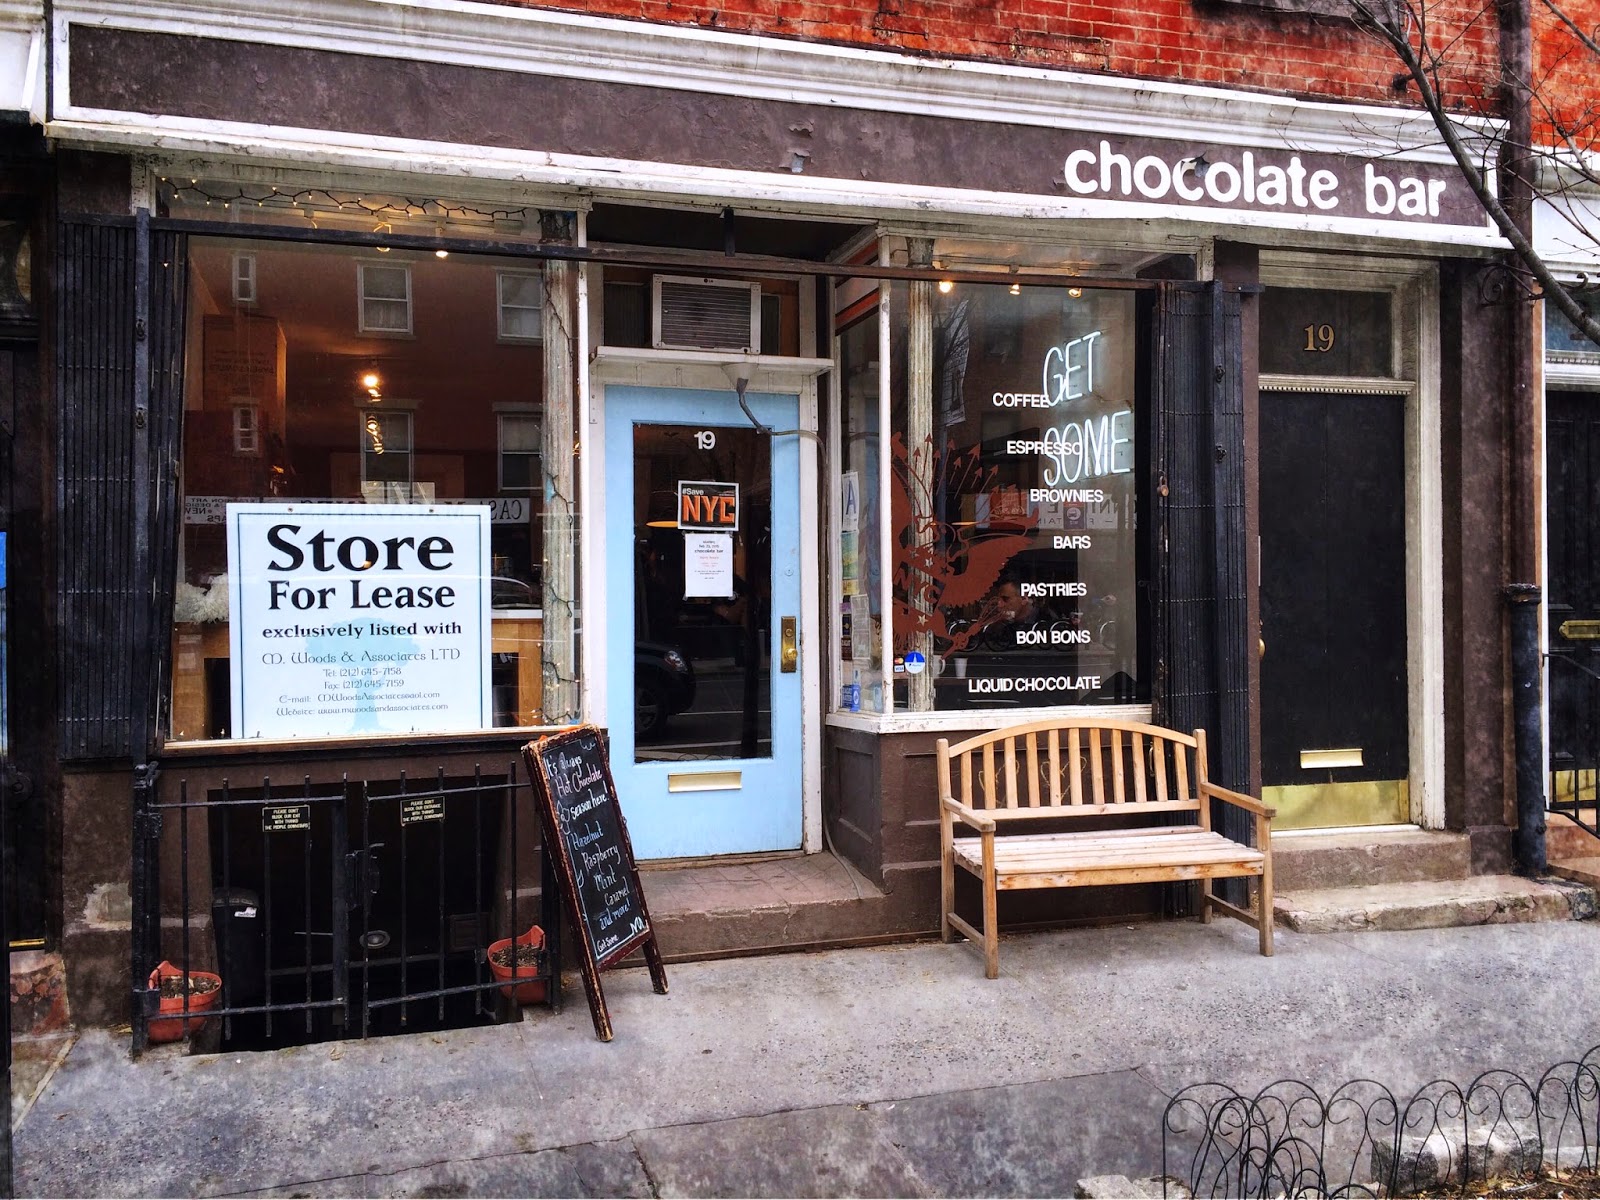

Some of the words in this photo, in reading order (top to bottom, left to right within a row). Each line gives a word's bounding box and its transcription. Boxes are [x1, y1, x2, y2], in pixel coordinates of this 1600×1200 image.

[1064, 140, 1339, 210] chocolate
[1365, 163, 1446, 217] bar
[1303, 323, 1335, 352] 19
[1043, 331, 1101, 406] GET
[992, 392, 1050, 408] COFFEE
[694, 430, 716, 450] 19
[1006, 440, 1083, 456] ESPRESSO
[1043, 410, 1131, 486] SOME
[682, 487, 704, 496] #Save
[1030, 488, 1104, 503] BROWNIES
[682, 494, 735, 523] NYC
[267, 524, 454, 572] Store
[1053, 535, 1091, 549] BARS
[268, 580, 336, 610] For
[350, 579, 456, 609] Lease
[1020, 582, 1087, 597] PASTRIES
[262, 623, 363, 639] exclusively
[370, 622, 417, 636] listed
[424, 621, 462, 634] with
[1016, 630, 1047, 644] BON
[1051, 630, 1091, 644] BONS
[262, 652, 285, 664] M.
[291, 651, 337, 664] Woods
[341, 651, 355, 663] &
[361, 650, 426, 662] Associates
[431, 648, 460, 660] LTD
[322, 668, 337, 677] Tel:
[339, 667, 359, 677] (212)
[361, 667, 402, 676] 645-7158
[342, 679, 363, 690] (212)
[364, 679, 405, 688] 645-7159
[968, 678, 1013, 693] LIQUID
[1015, 675, 1101, 692] CHOCOLATE
[276, 707, 315, 716] Website:
[543, 755, 558, 780] It's
[555, 773, 572, 798] Hot
[572, 763, 603, 793] Chocolate
[571, 820, 603, 850] Hazelnut
[581, 842, 621, 875] Raspberry
[593, 864, 618, 892] Mint
[604, 876, 630, 906] Caramel
[599, 907, 613, 931] and
[596, 939, 606, 952] Get
